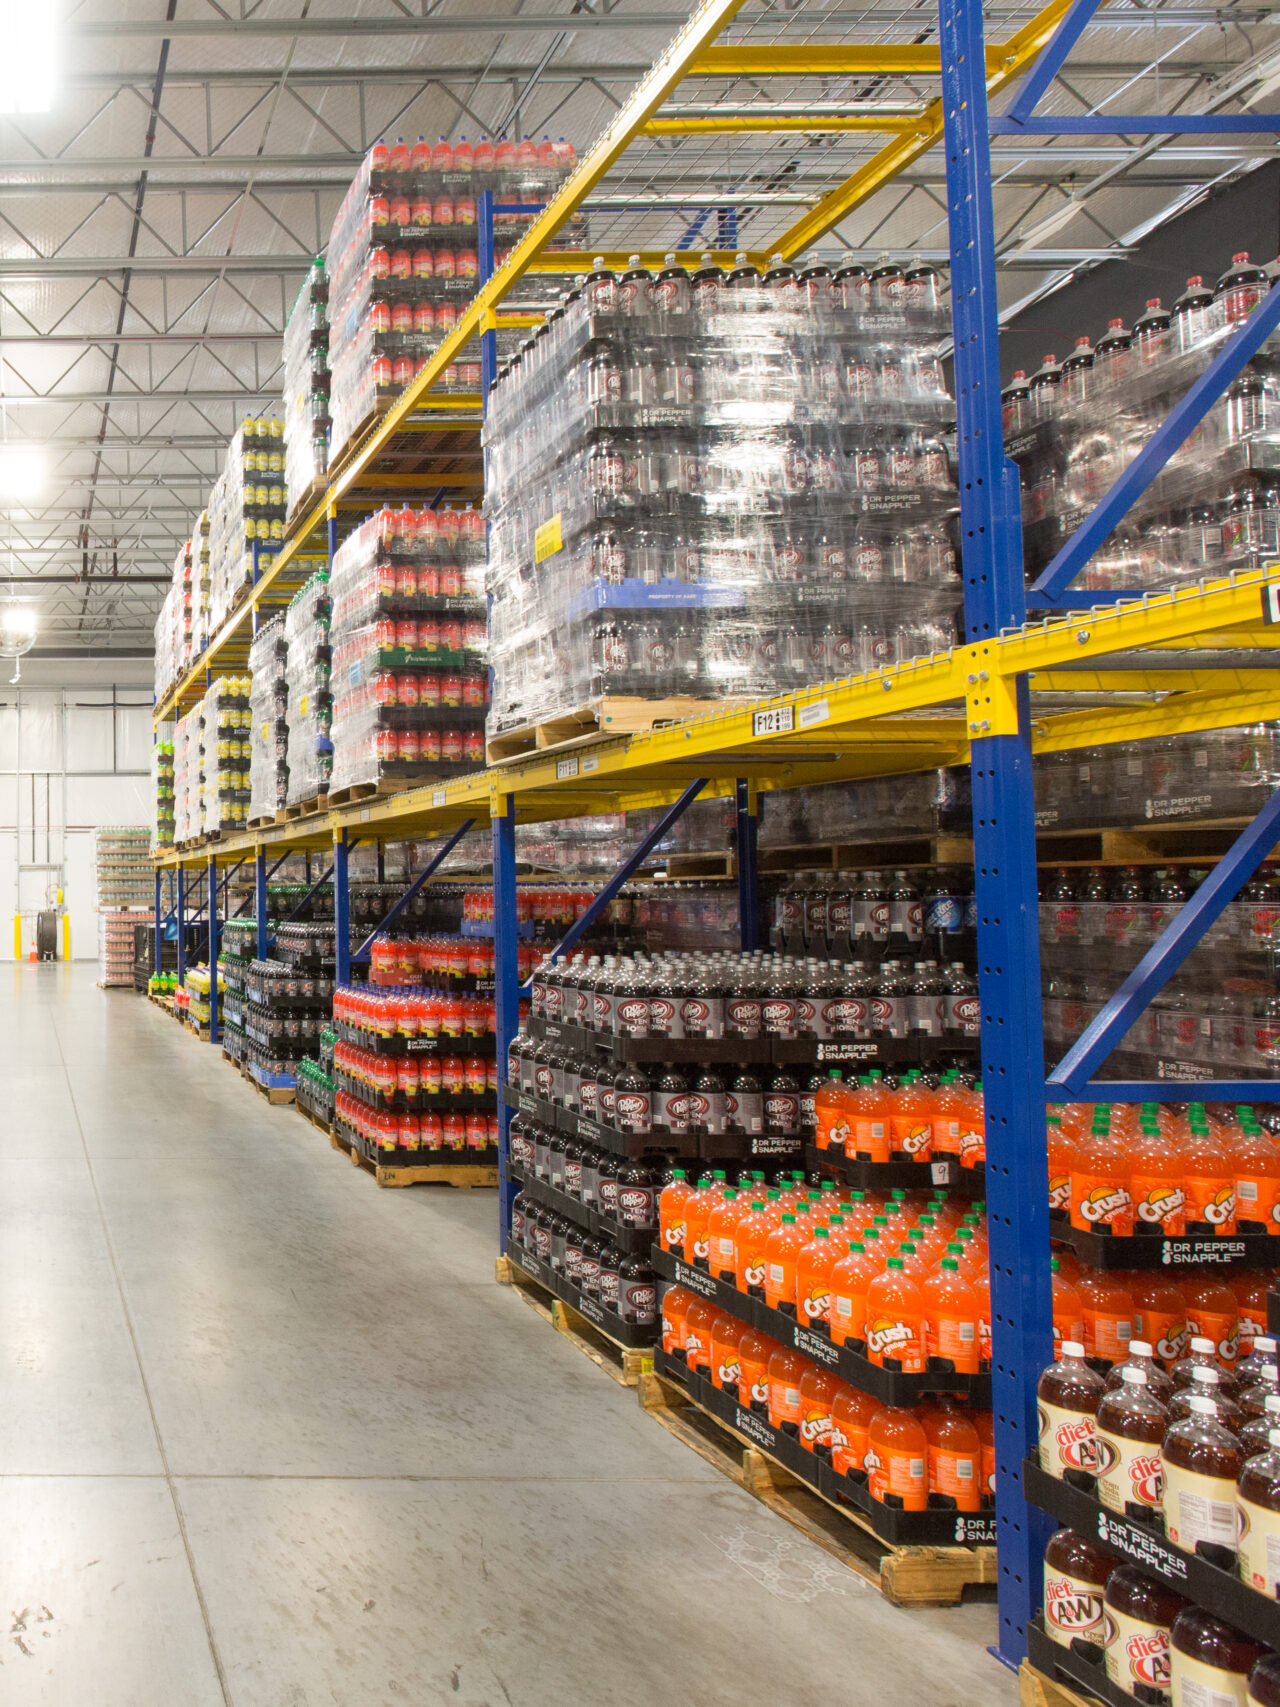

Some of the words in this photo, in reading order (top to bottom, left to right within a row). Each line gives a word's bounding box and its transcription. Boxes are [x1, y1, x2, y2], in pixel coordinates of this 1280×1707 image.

[870, 502, 912, 510] SNAPPLE
[884, 494, 921, 502] PEPPER
[757, 713, 774, 732] F12
[1153, 800, 1168, 808] DR
[1170, 794, 1212, 806] PEPPER
[1154, 806, 1201, 817] SNAPPLE
[622, 1005, 648, 1018] Pepper
[763, 1007, 789, 1018] Pepper
[825, 1052, 868, 1060] SNAPPLE
[840, 1044, 878, 1052] PEPPER
[1179, 1064, 1214, 1076] PEPPER
[618, 1100, 642, 1112] Pepper
[938, 1165, 946, 1181] 9
[1080, 1188, 1131, 1222] Crush
[1173, 1243, 1191, 1252] DR
[1195, 1242, 1246, 1252] PEPPER
[1173, 1253, 1231, 1263] SNAPPLE
[680, 1266, 690, 1275] DR
[691, 1269, 717, 1289] PEPPER
[681, 1275, 711, 1296] SNAPPLE
[800, 1332, 809, 1344] DR
[810, 1336, 839, 1358] PEPPER
[869, 1323, 913, 1352] Crush
[800, 1341, 832, 1364] SNAPPLE
[740, 1413, 750, 1424] DR
[751, 1418, 776, 1442] PEPPER
[741, 1420, 770, 1447] SNAPPLE
[1058, 1419, 1095, 1447] diet
[1130, 1457, 1161, 1481] die
[967, 1520, 986, 1530] DR
[1109, 1520, 1127, 1539] DR
[1131, 1531, 1187, 1573] PEPPER
[1109, 1533, 1173, 1578] SNAPPLE
[1057, 1596, 1094, 1625] A&W
[1127, 1634, 1169, 1659] diet
